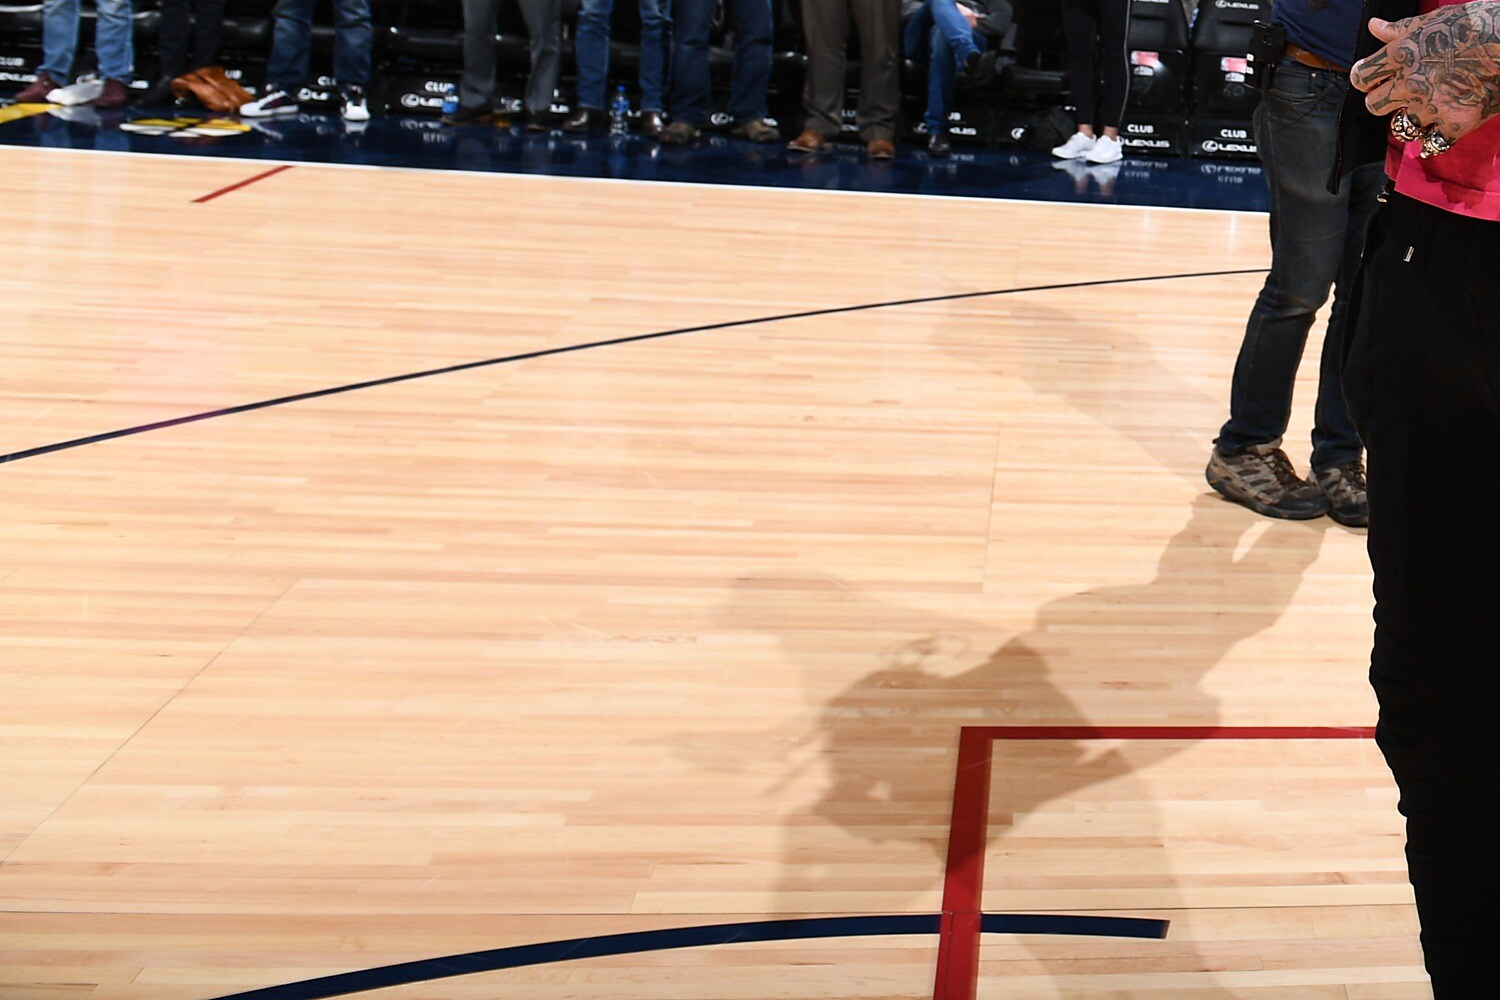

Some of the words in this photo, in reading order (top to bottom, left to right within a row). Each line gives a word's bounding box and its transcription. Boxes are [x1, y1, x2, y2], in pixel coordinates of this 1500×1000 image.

[1127, 124, 1154, 134] CLUB
[1220, 129, 1248, 139] CLUB
[1124, 138, 1170, 149] LEXUS
